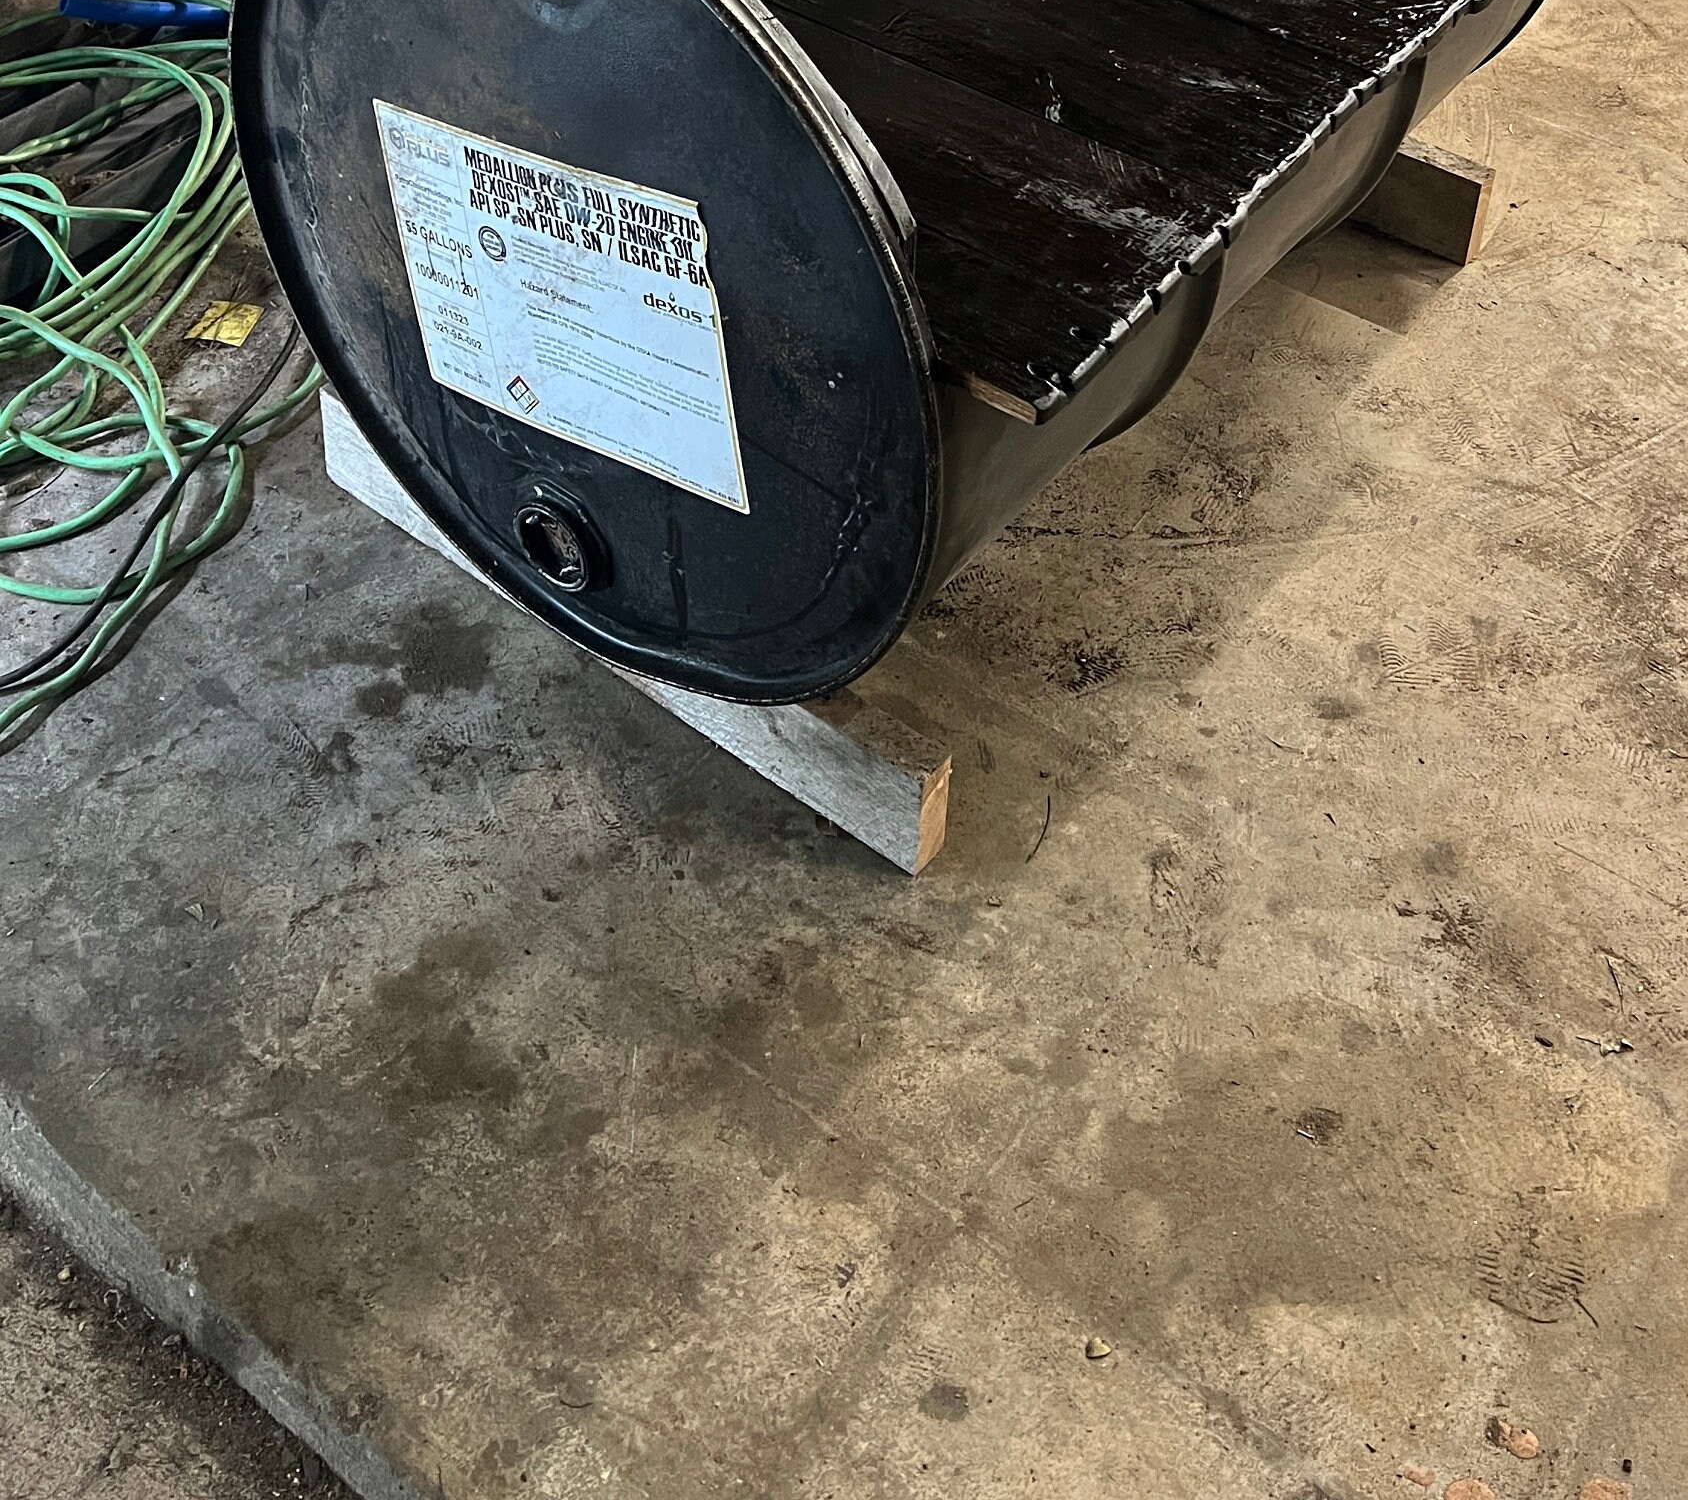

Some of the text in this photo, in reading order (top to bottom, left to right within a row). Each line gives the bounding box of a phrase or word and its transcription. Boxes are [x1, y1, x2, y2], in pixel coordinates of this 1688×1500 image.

[407, 142, 451, 168] PLUS
[464, 146, 701, 243] MEDALLION PLUS FULL SYNTHETIC
[405, 219, 418, 236] 55
[419, 225, 473, 259] GALLONS
[469, 188, 492, 214] API
[517, 207, 537, 231] SN
[538, 211, 580, 248] PLUS,
[581, 228, 603, 254] SN
[607, 237, 613, 257] /
[617, 240, 662, 273] ILSAC
[664, 257, 710, 289] GF-6A
[533, 192, 563, 220] SAE
[563, 201, 616, 237] 0W-20
[618, 220, 671, 255] ENGINE
[670, 237, 697, 264] OIL
[437, 305, 470, 327] 011323
[643, 292, 703, 324] dexos
